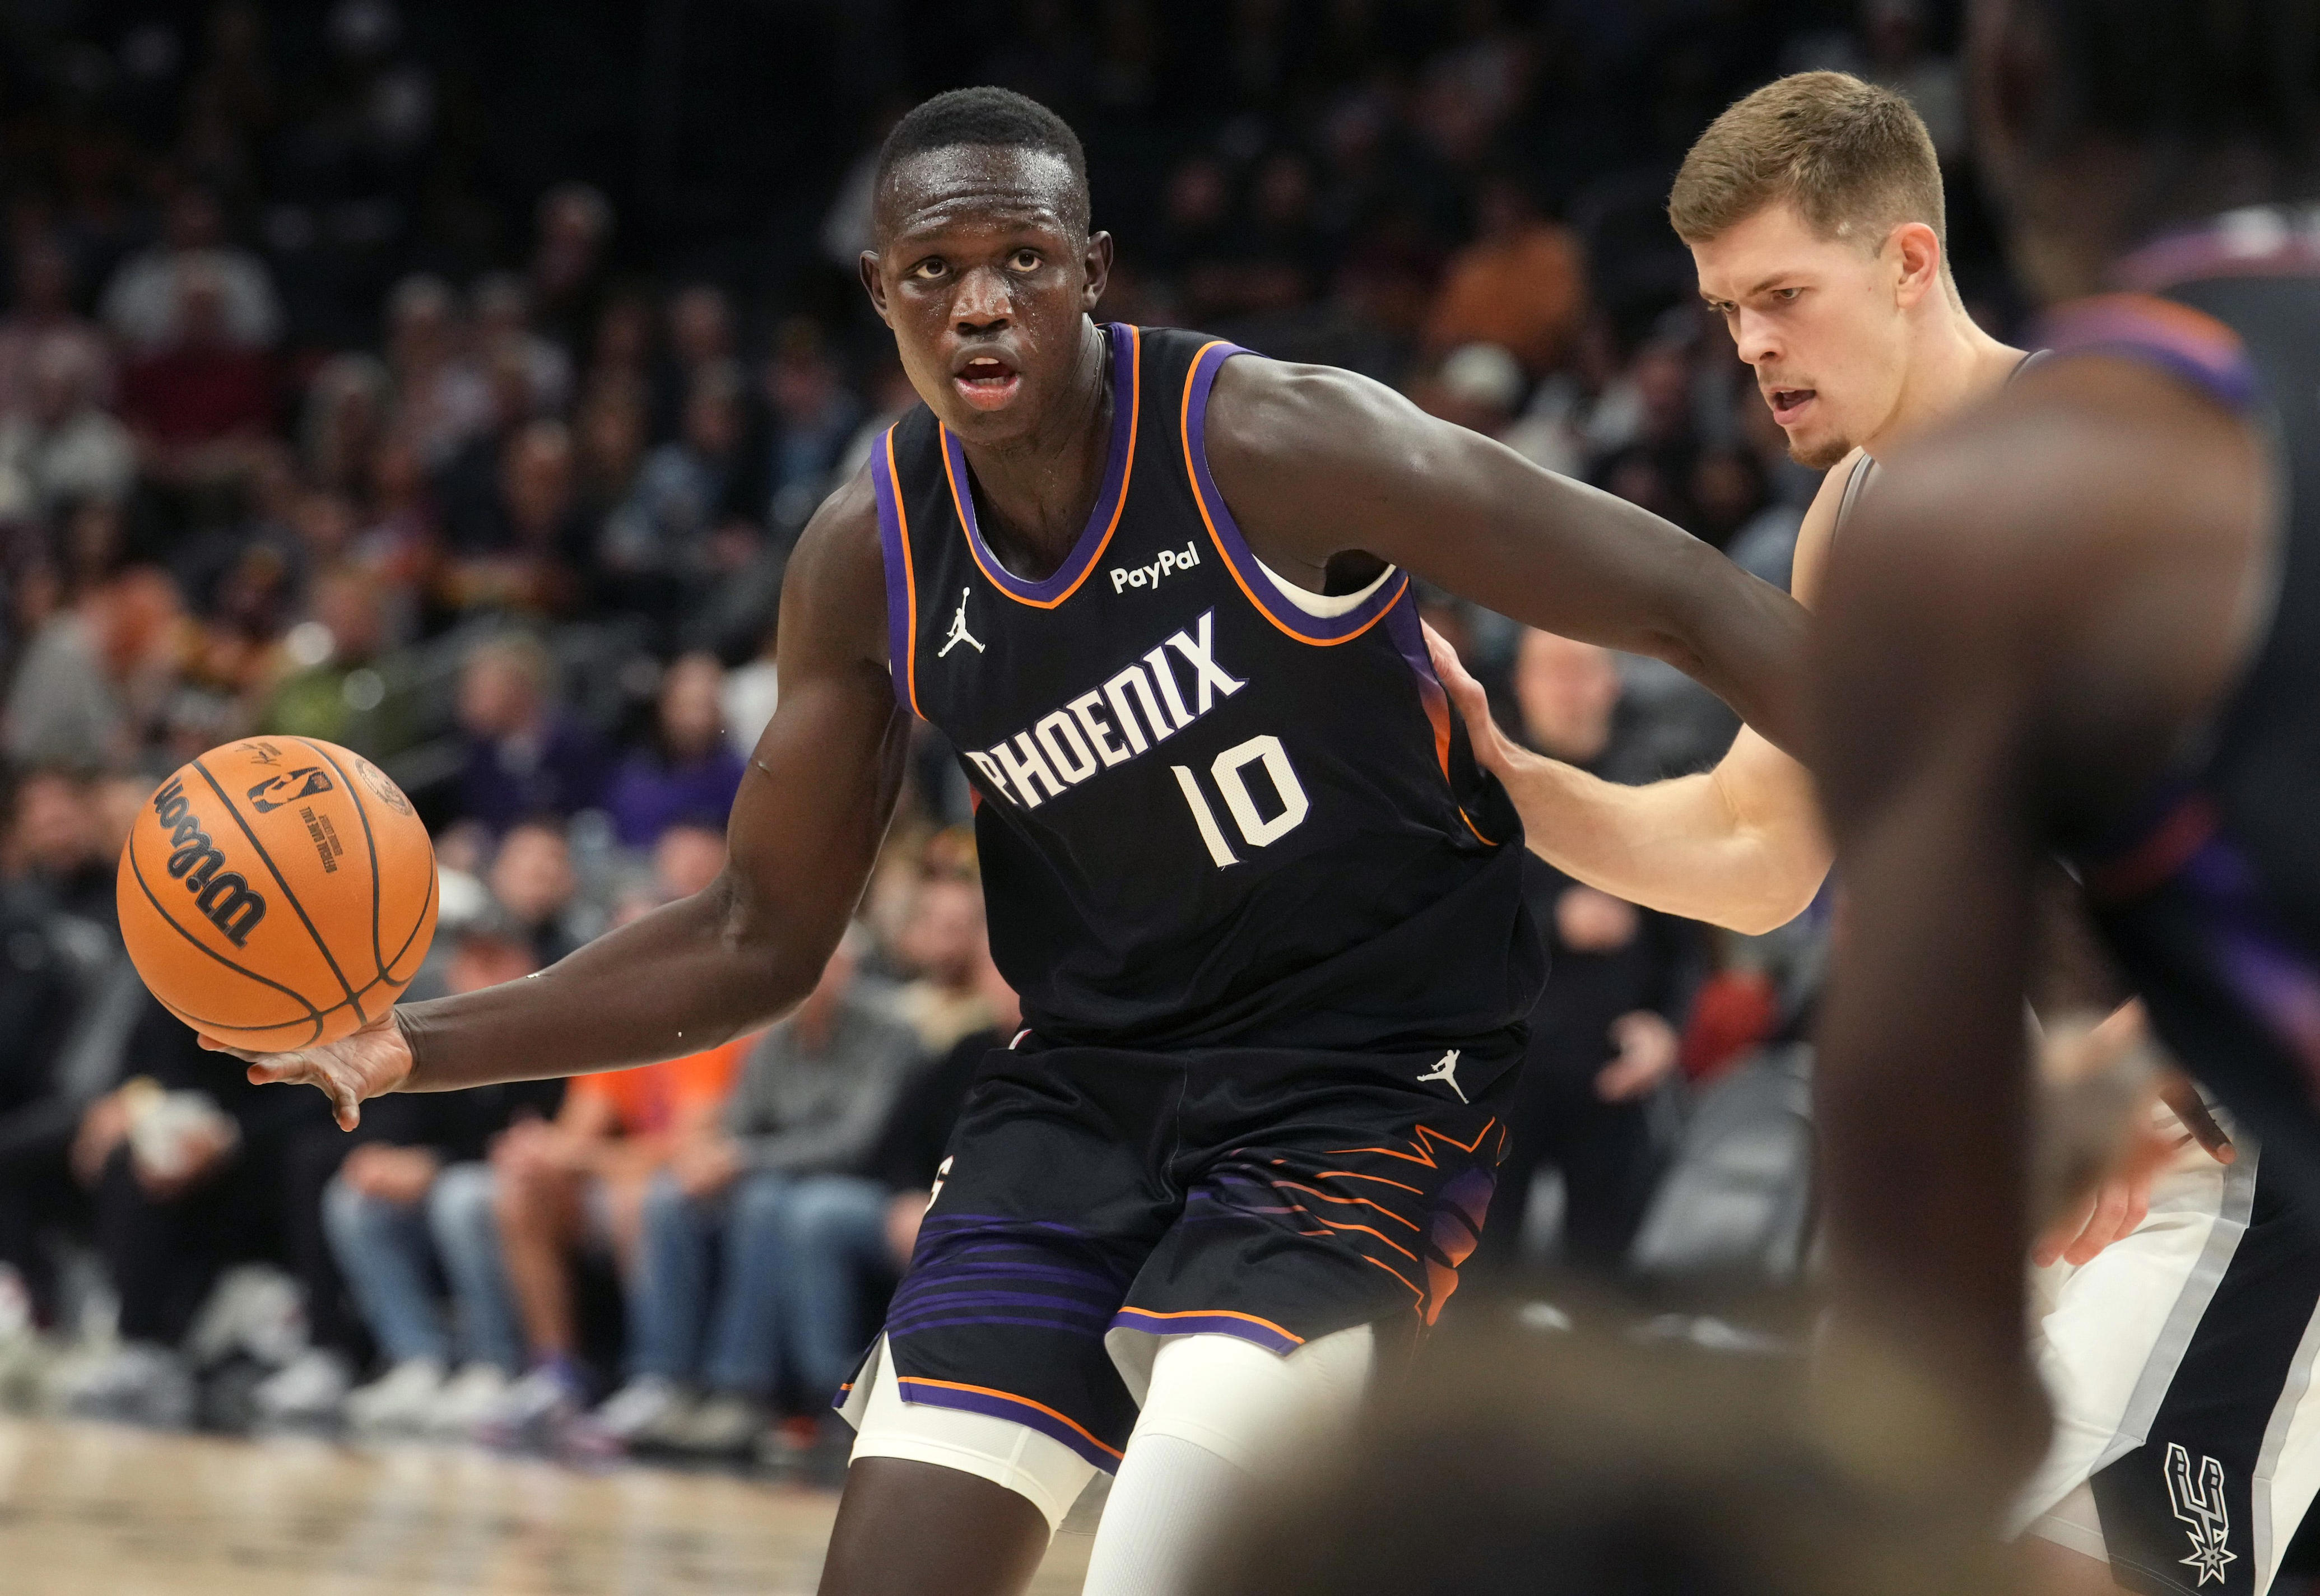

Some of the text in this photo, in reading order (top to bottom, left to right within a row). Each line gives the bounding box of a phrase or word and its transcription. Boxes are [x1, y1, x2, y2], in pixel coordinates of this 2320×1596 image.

[1110, 541, 1201, 594] PayPal
[965, 608, 1247, 809] PHOENIX
[154, 774, 266, 950] Wilson
[1170, 734, 1310, 872] 10
